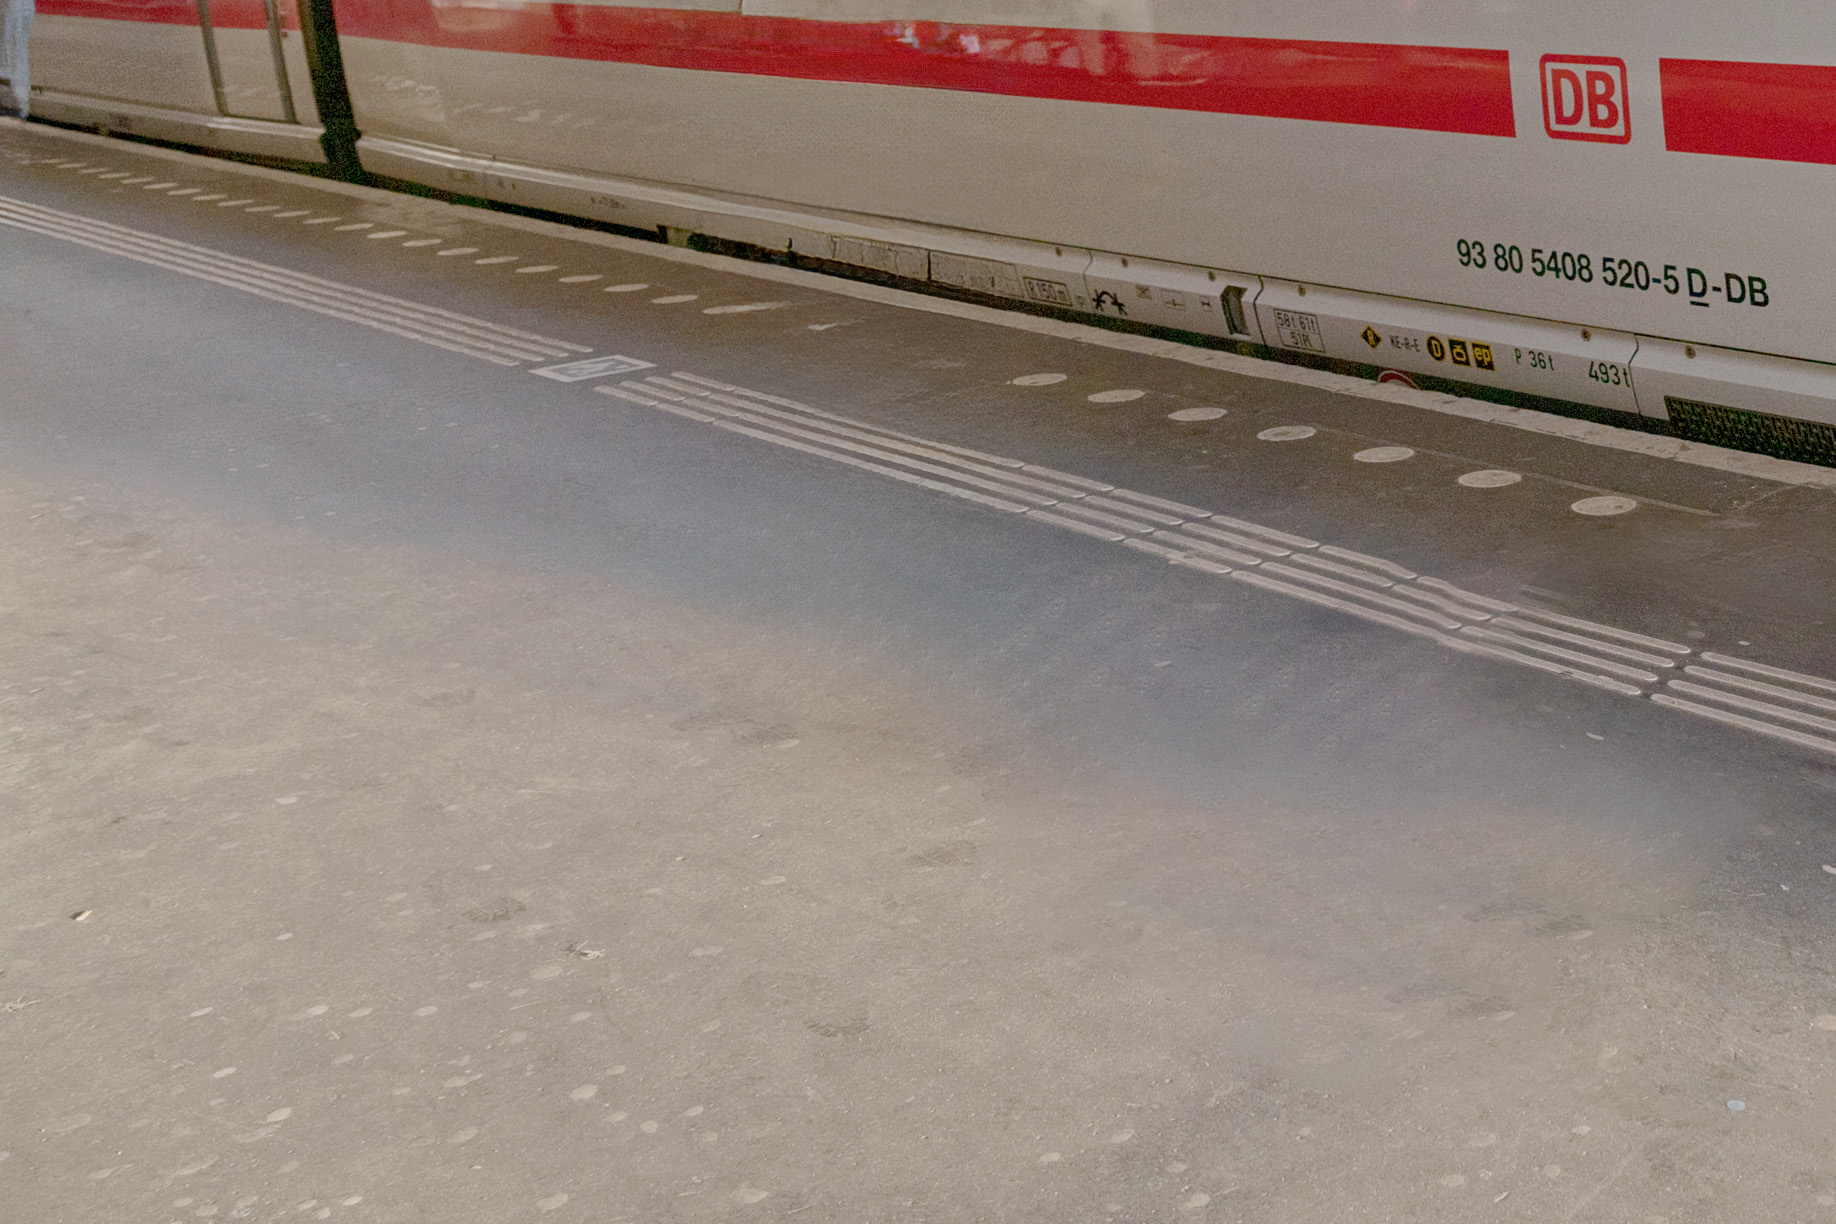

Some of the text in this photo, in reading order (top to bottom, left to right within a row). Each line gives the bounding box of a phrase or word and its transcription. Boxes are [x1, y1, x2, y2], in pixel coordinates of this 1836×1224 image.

[1551, 68, 1620, 129] DB
[1457, 239, 1769, 308] 93 80 5408 520-5 D-DB
[1514, 347, 1521, 364] P
